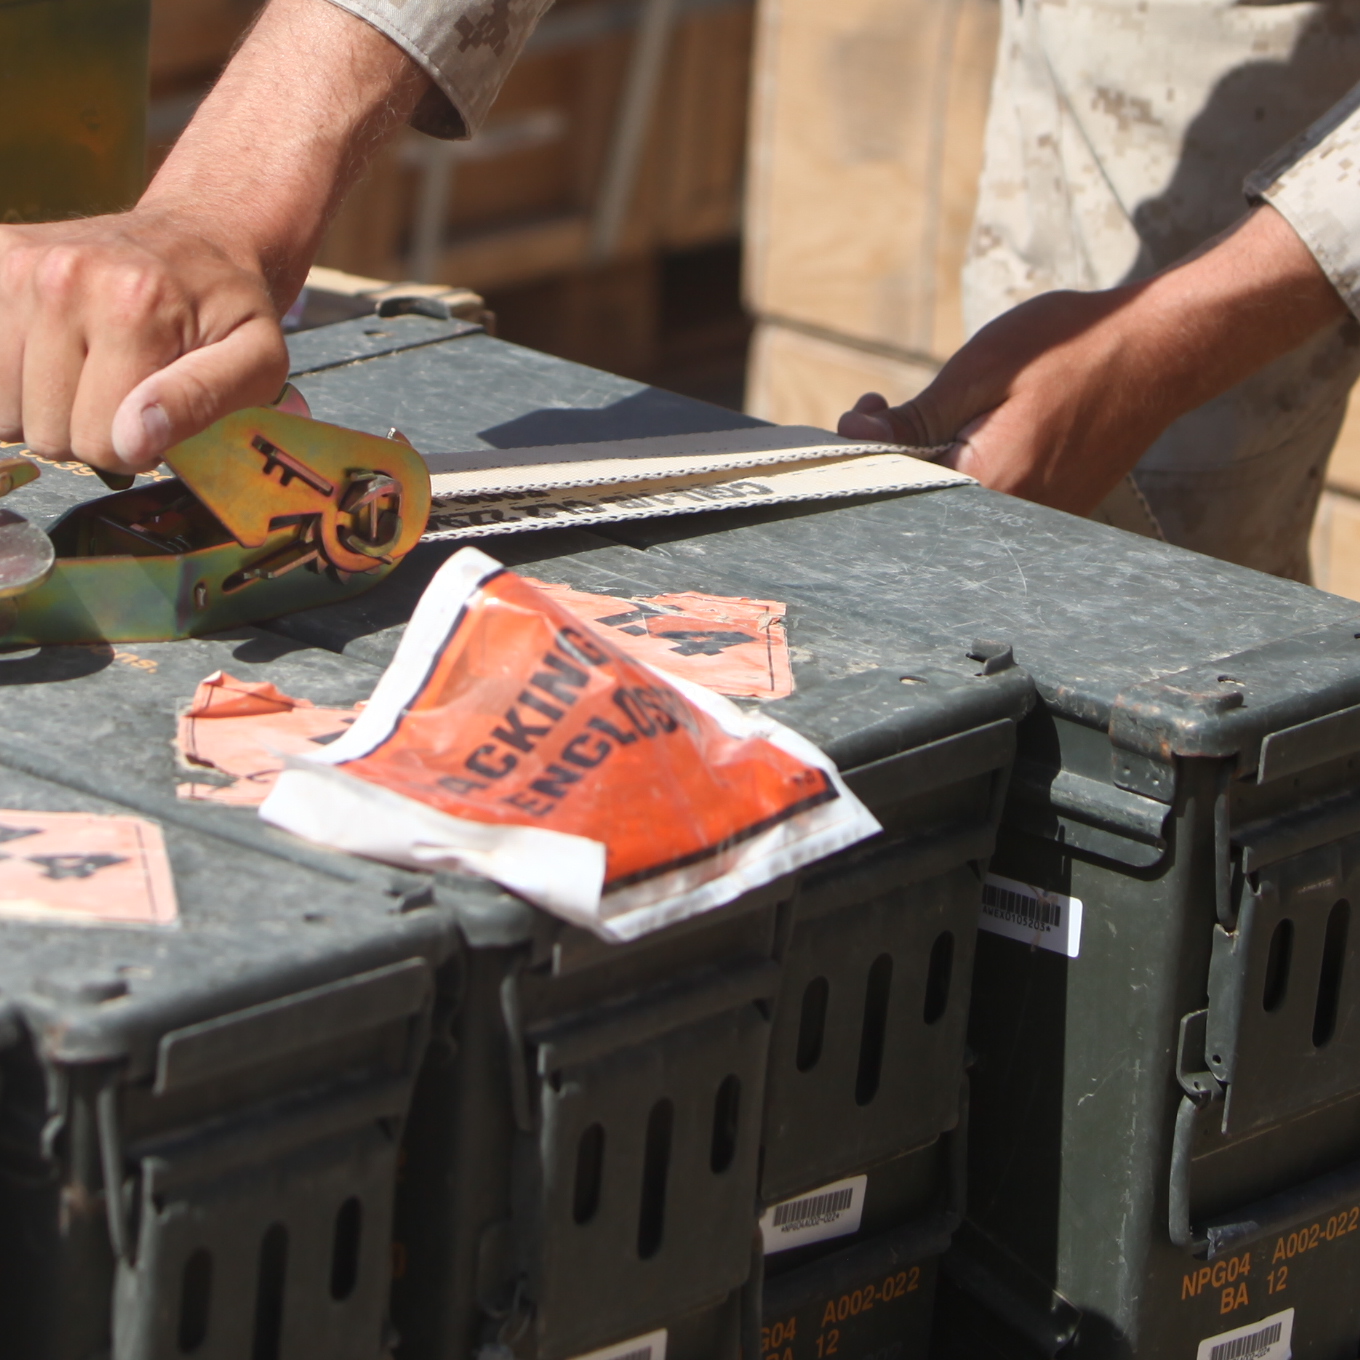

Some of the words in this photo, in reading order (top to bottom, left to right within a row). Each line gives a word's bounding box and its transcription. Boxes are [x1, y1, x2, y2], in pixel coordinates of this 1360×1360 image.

[1181, 1252, 1251, 1300] NPG04
[1272, 1206, 1360, 1265] A002-022
[821, 1265, 921, 1328] A002-022
[1220, 1281, 1249, 1315] BA
[1266, 1265, 1288, 1295] 12
[815, 1328, 840, 1359] 12
